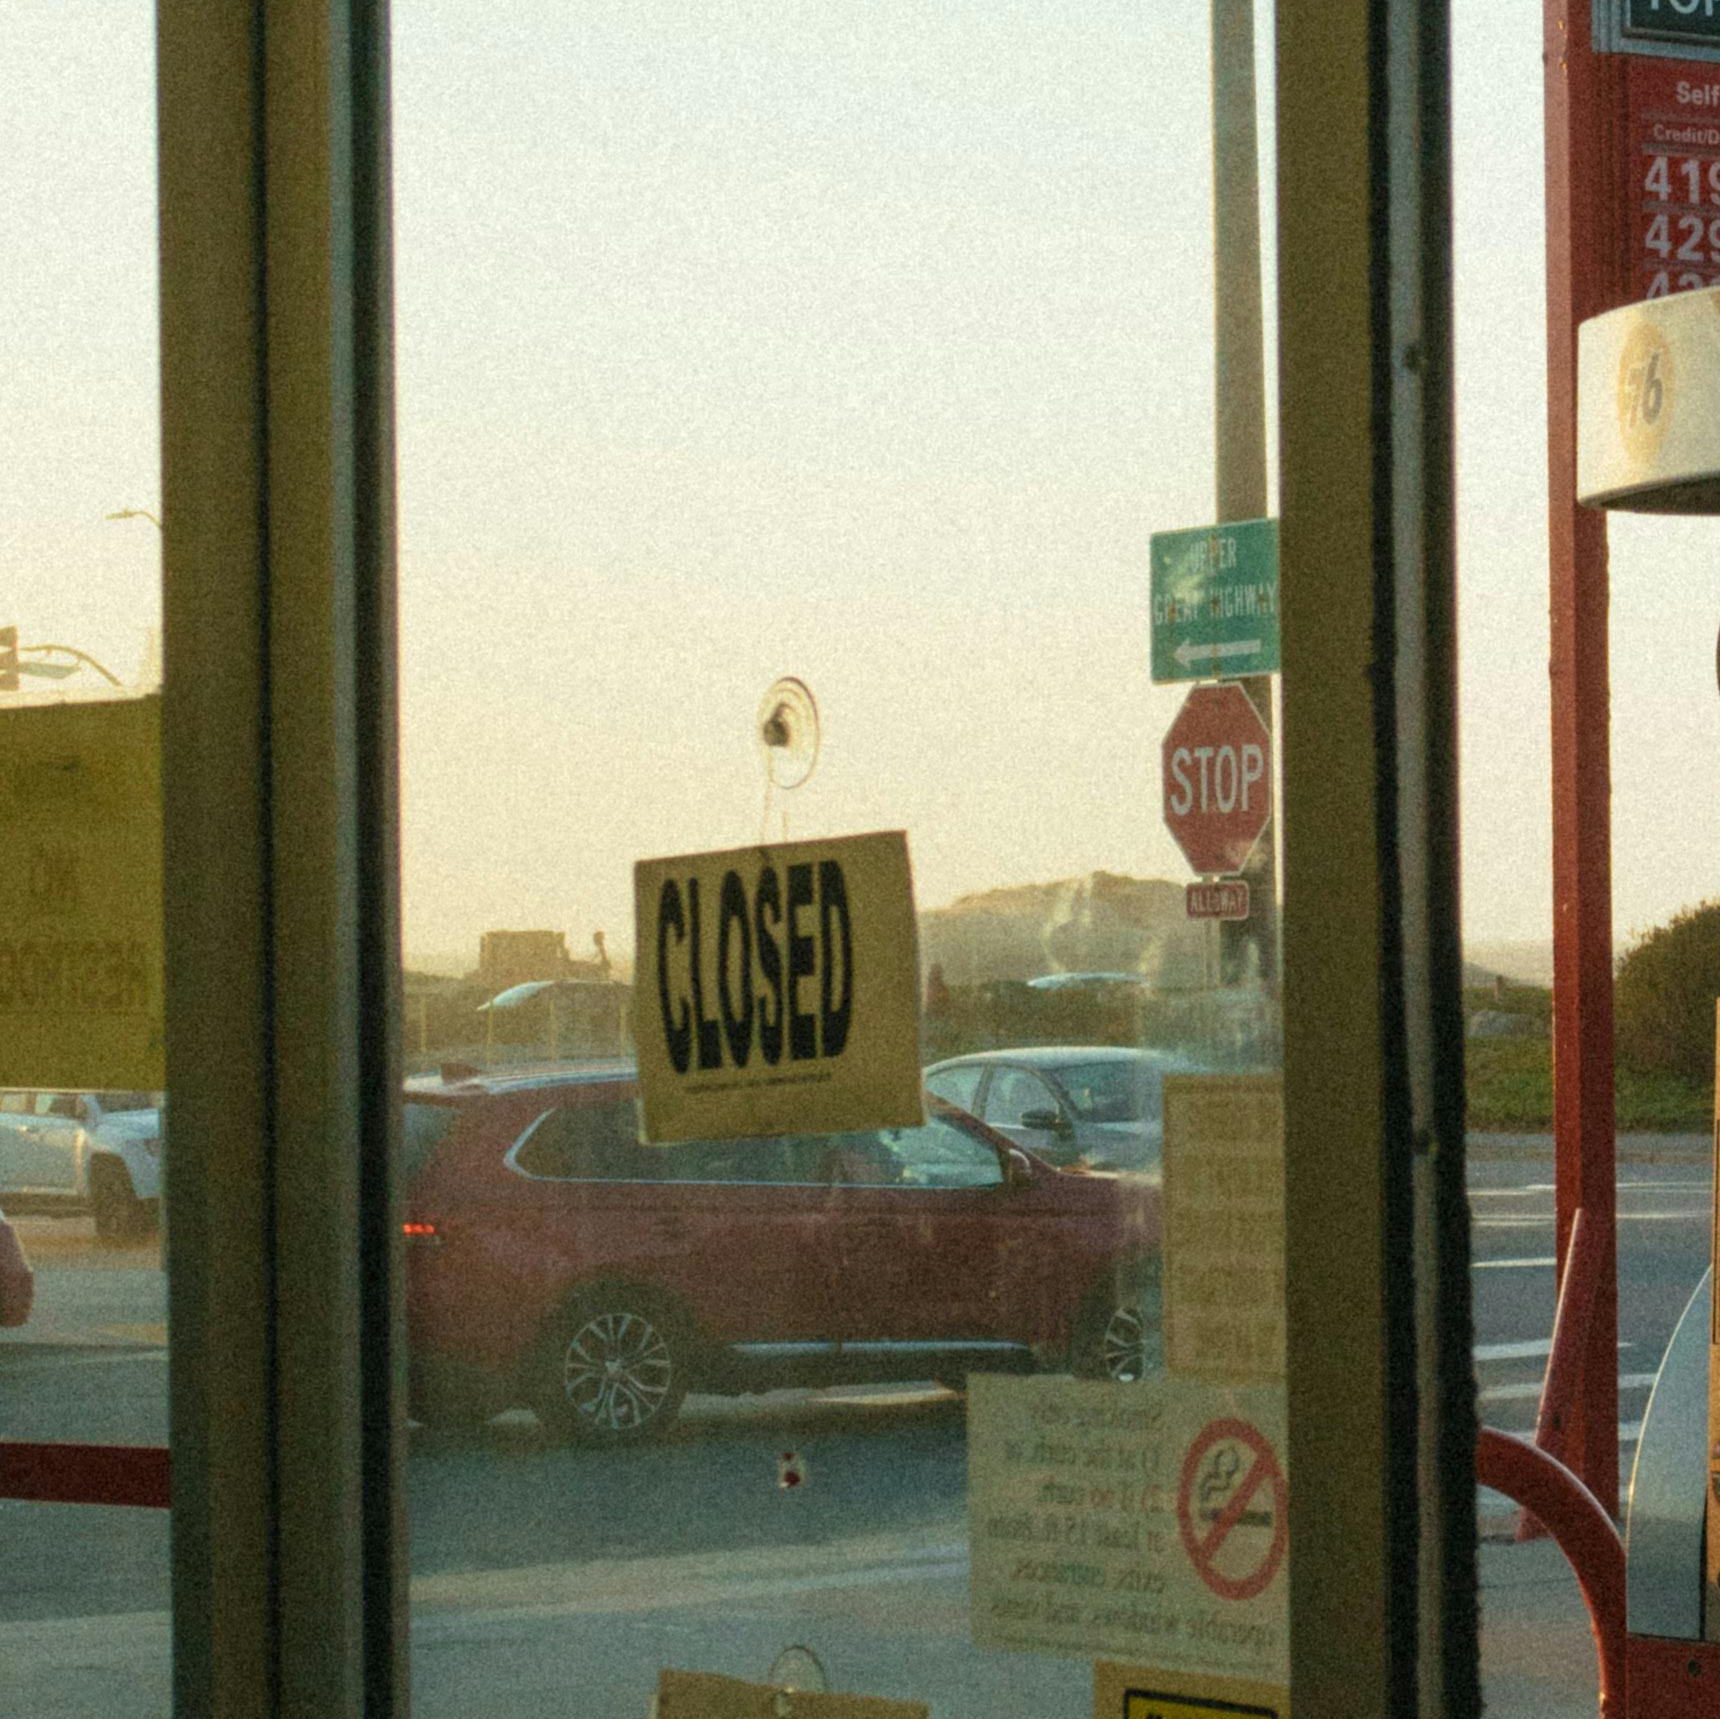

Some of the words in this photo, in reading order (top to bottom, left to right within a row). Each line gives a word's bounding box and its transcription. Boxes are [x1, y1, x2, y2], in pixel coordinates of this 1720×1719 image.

[1209, 582, 1278, 618] HIGHWAY
[1170, 743, 1265, 817] STOP
[658, 859, 853, 1075] CLOSED
